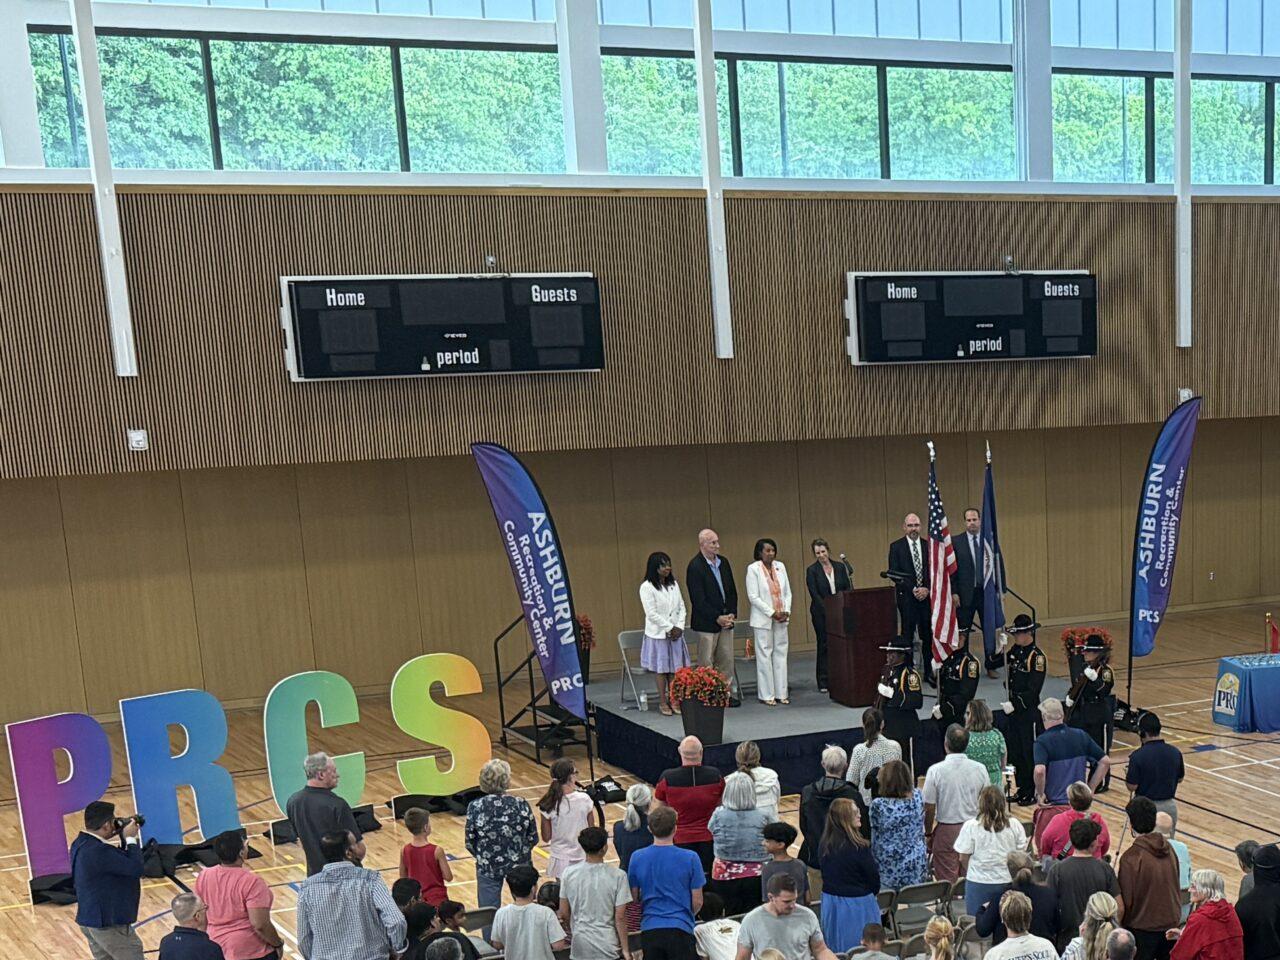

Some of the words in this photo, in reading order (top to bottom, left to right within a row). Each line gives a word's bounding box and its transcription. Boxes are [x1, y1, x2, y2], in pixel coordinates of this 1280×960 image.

[325, 288, 365, 306] Home
[531, 285, 577, 303] Guests
[887, 282, 918, 300] Home
[1044, 280, 1080, 297] Guests
[436, 348, 480, 368] period
[969, 336, 1003, 355] period
[1138, 462, 1167, 584] ASHBURN
[1154, 502, 1173, 571] Recreation
[1159, 511, 1180, 588] Community
[1171, 466, 1185, 510] Center
[503, 520, 535, 606] Community
[530, 608, 550, 659] Center
[518, 534, 548, 615] Recreation
[542, 615, 554, 631] &
[527, 512, 576, 646] ASHBURN
